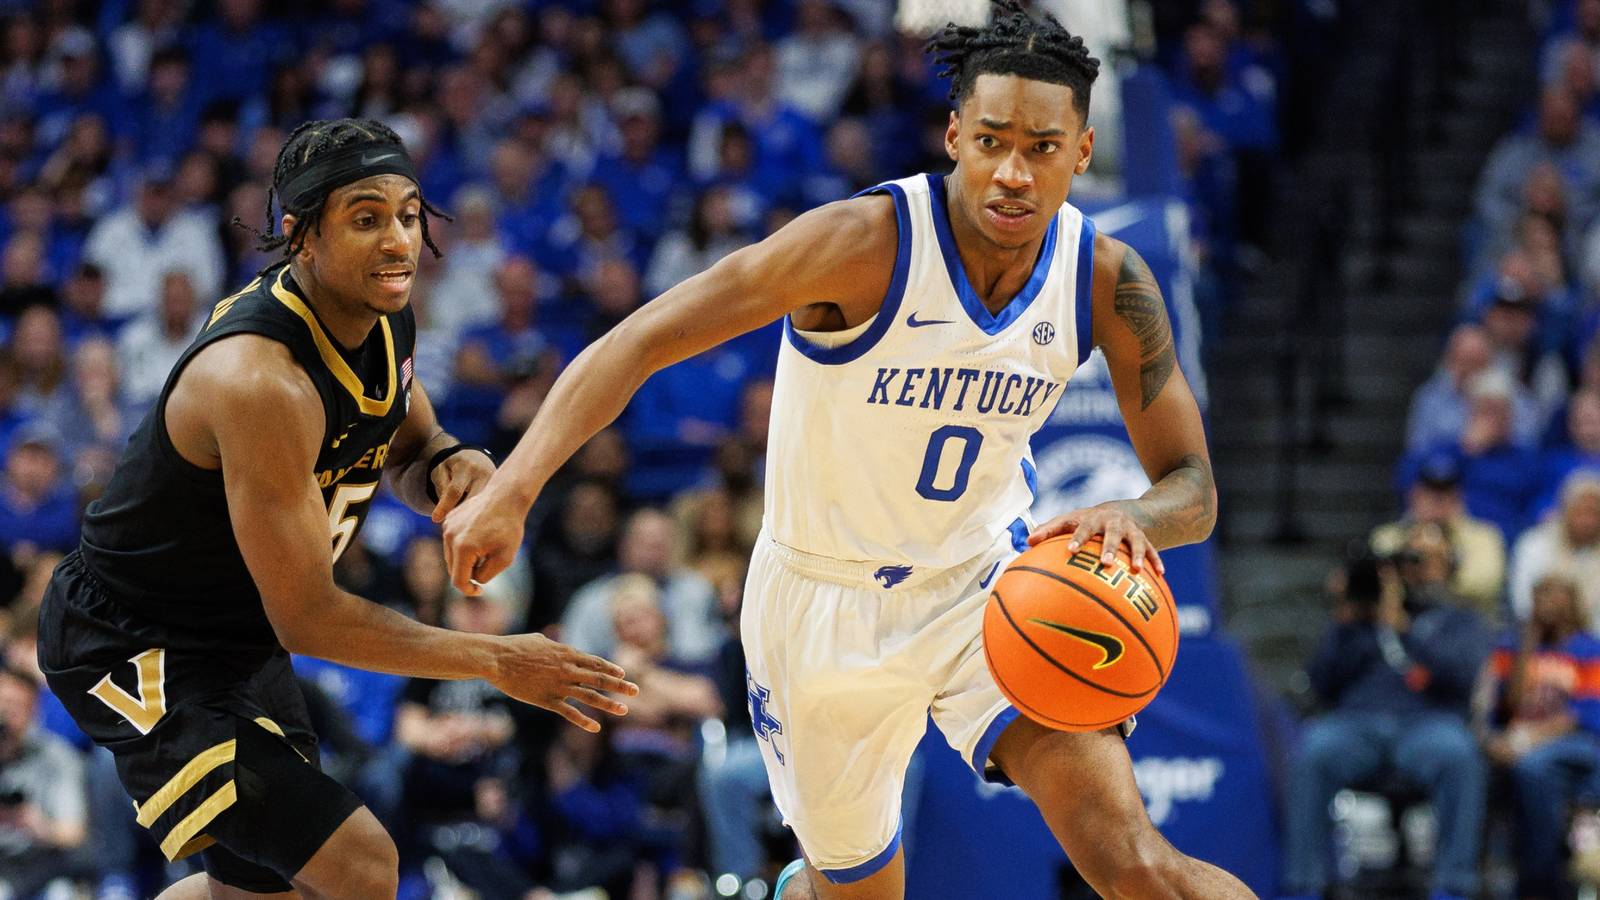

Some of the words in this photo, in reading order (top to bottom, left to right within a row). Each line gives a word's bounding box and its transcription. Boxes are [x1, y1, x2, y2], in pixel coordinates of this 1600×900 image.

[1033, 321, 1055, 345] SEC
[866, 367, 1060, 416] KENTUCKY
[914, 424, 984, 502] 0
[1066, 550, 1159, 623] ELITE
[86, 647, 167, 736] V
